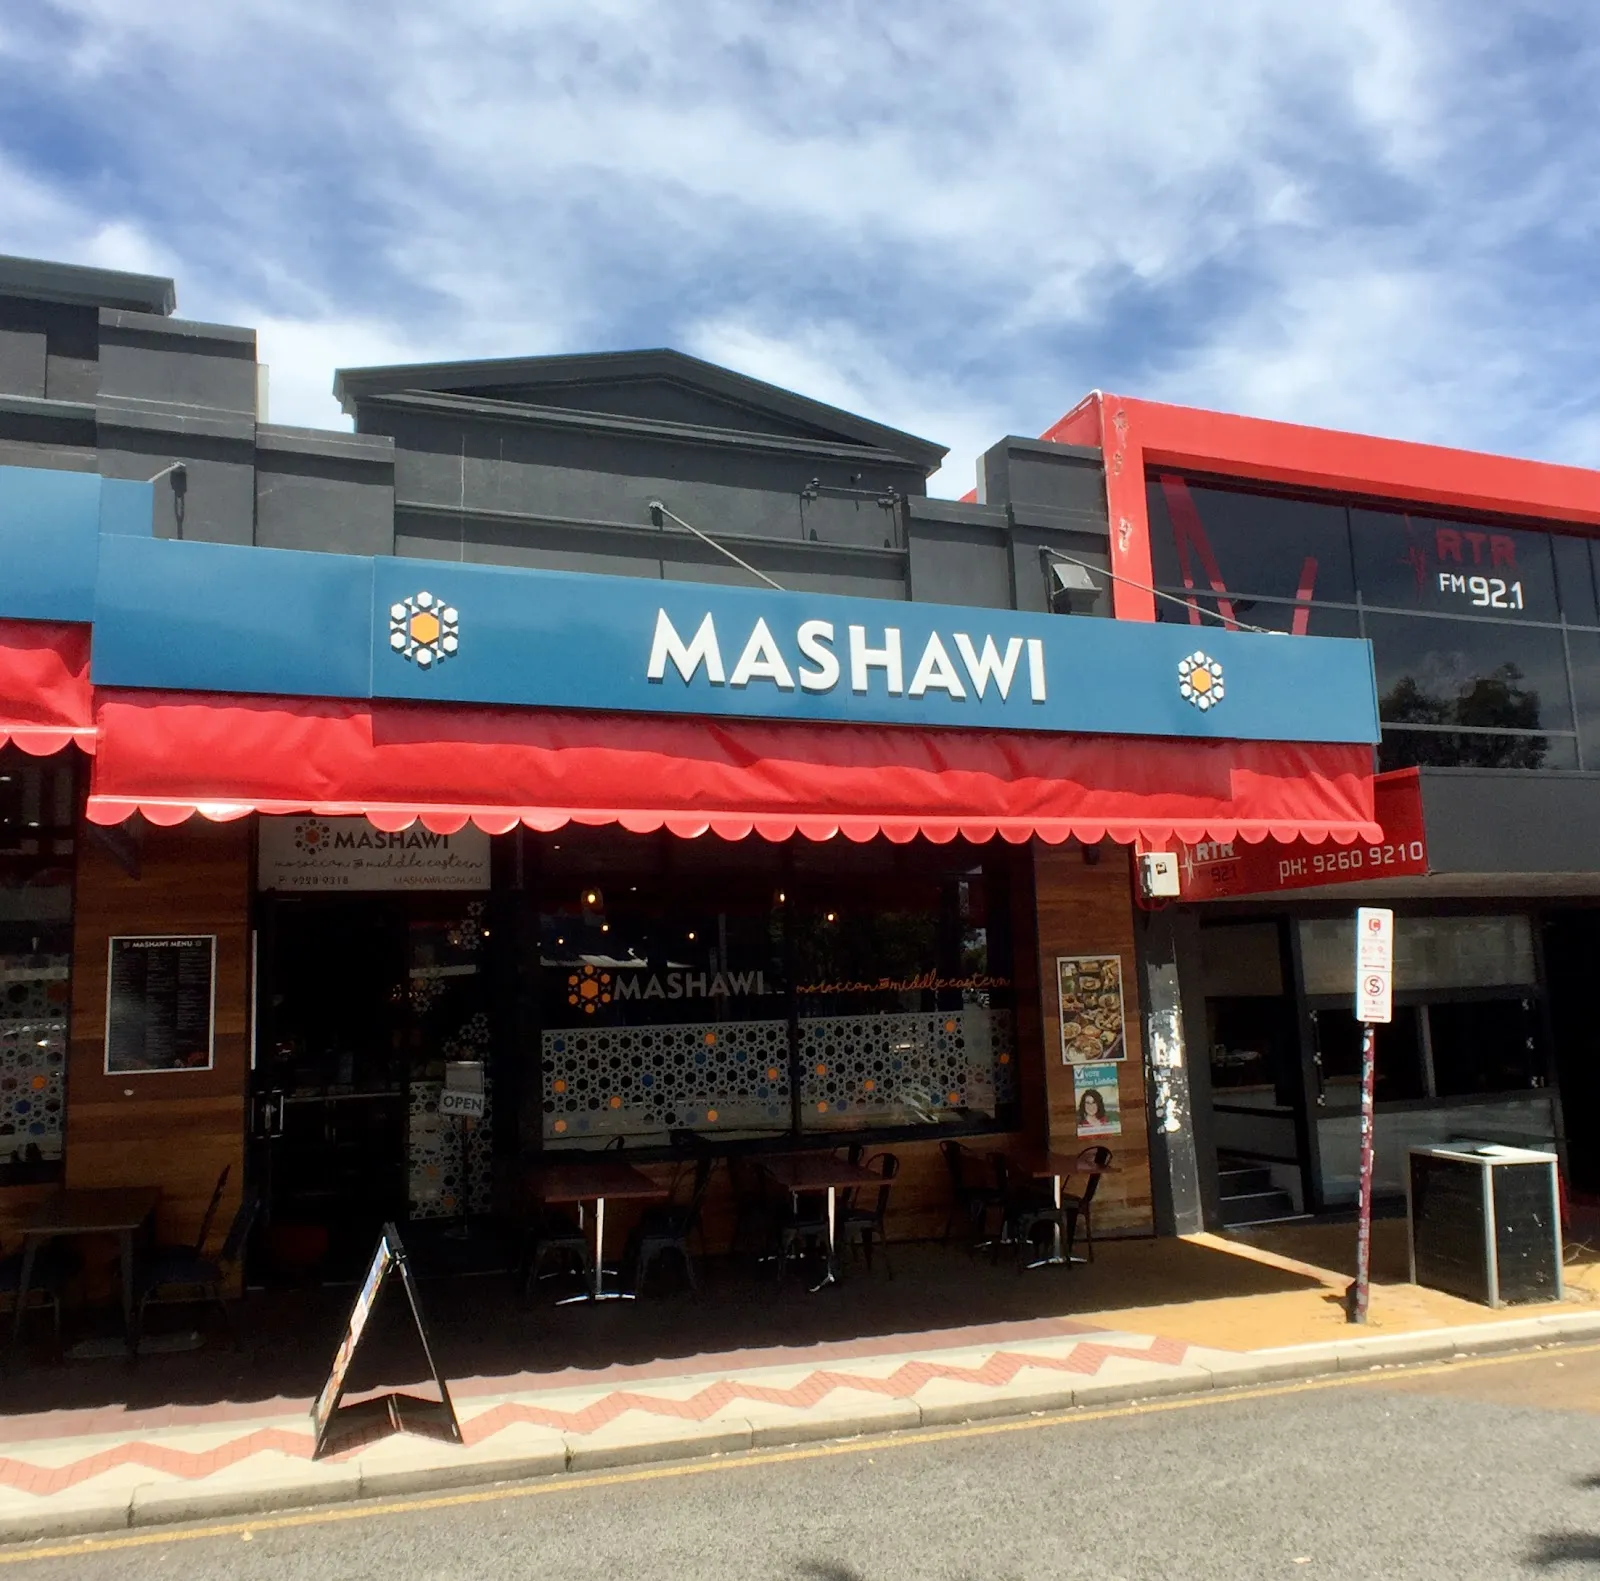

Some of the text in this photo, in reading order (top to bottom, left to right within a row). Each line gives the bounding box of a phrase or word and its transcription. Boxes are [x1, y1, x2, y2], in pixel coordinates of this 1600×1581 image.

[1436, 528, 1518, 570] RTR
[1438, 572, 1524, 610] FM 92.1
[647, 607, 1047, 706] MASHAWI
[333, 831, 449, 849] MASHAWI
[1196, 841, 1234, 861] RTR
[366, 852, 425, 869] middle
[1313, 850, 1363, 874] 9260
[1370, 841, 1424, 866] 9210
[613, 970, 765, 1001] MASHAWI
[889, 968, 947, 991] middle
[948, 972, 1011, 991] eastern
[443, 1095, 482, 1112] OPEN
